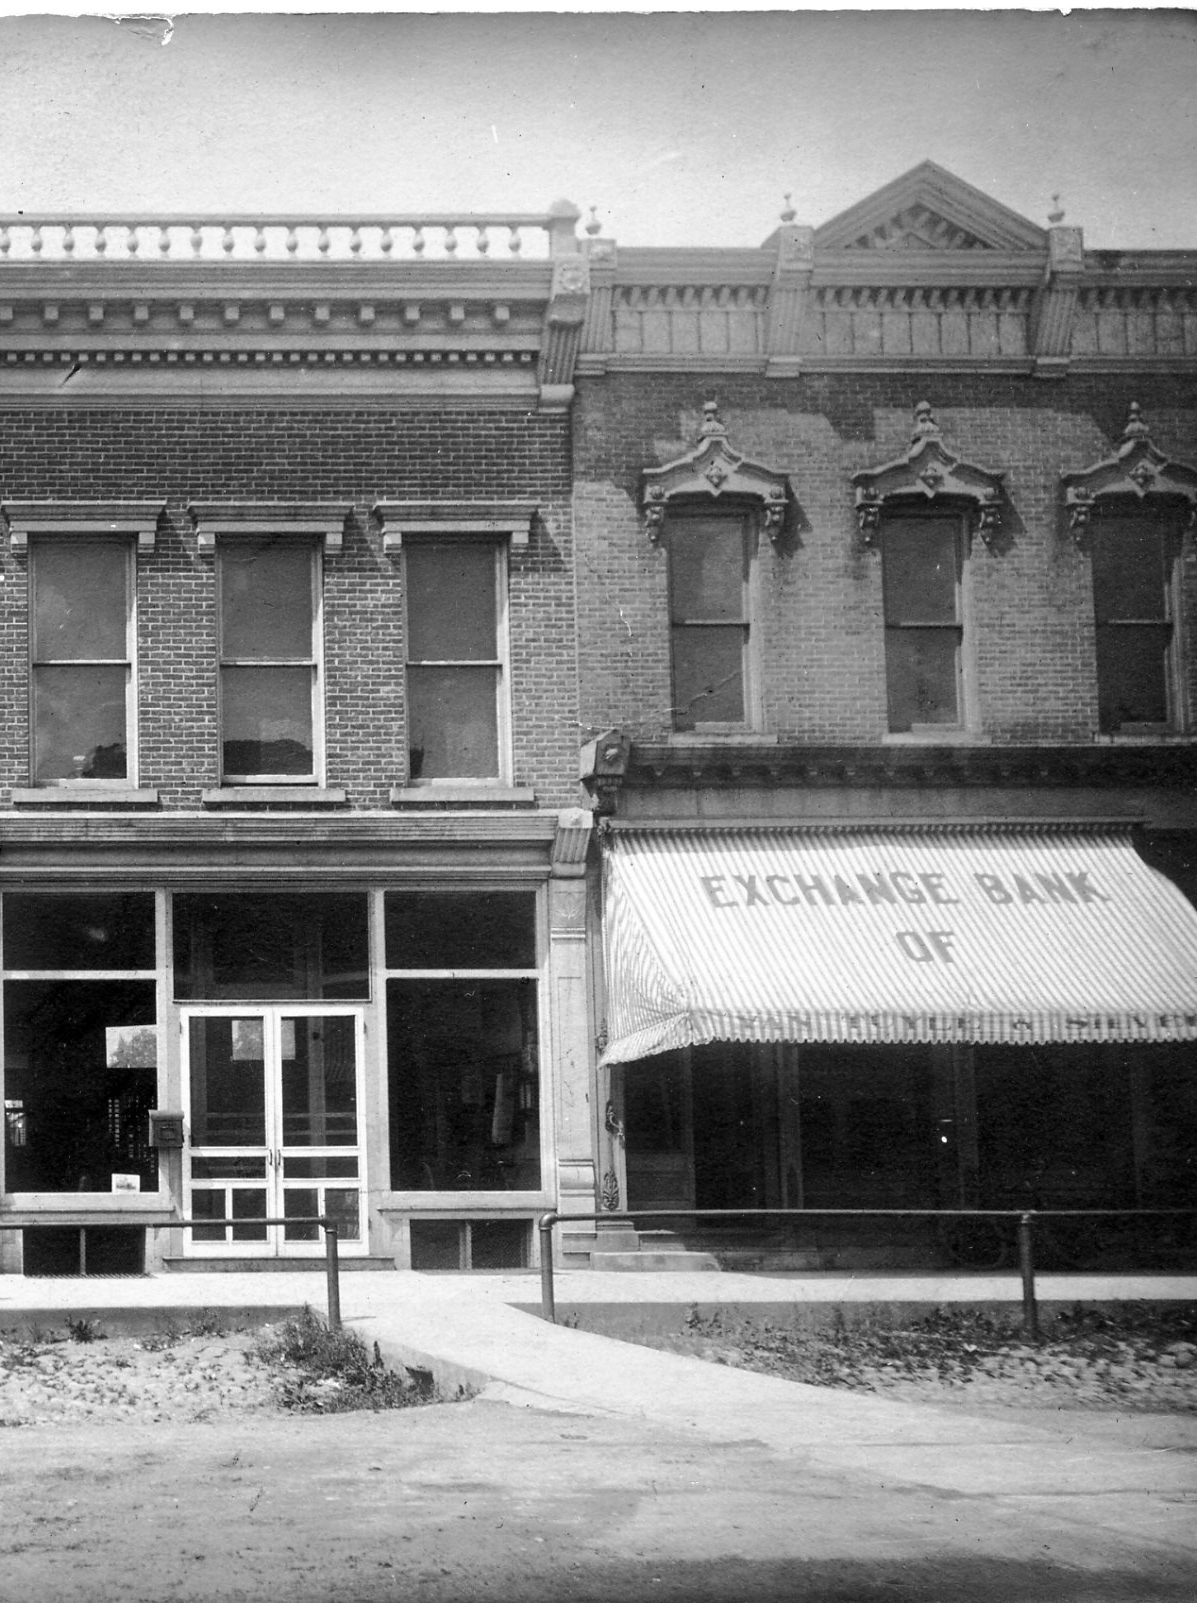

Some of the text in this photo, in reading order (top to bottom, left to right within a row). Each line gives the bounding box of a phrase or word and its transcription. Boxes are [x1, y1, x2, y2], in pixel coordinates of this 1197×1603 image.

[701, 871, 1111, 908] EXCHANGE BANK
[896, 931, 956, 963] OF
